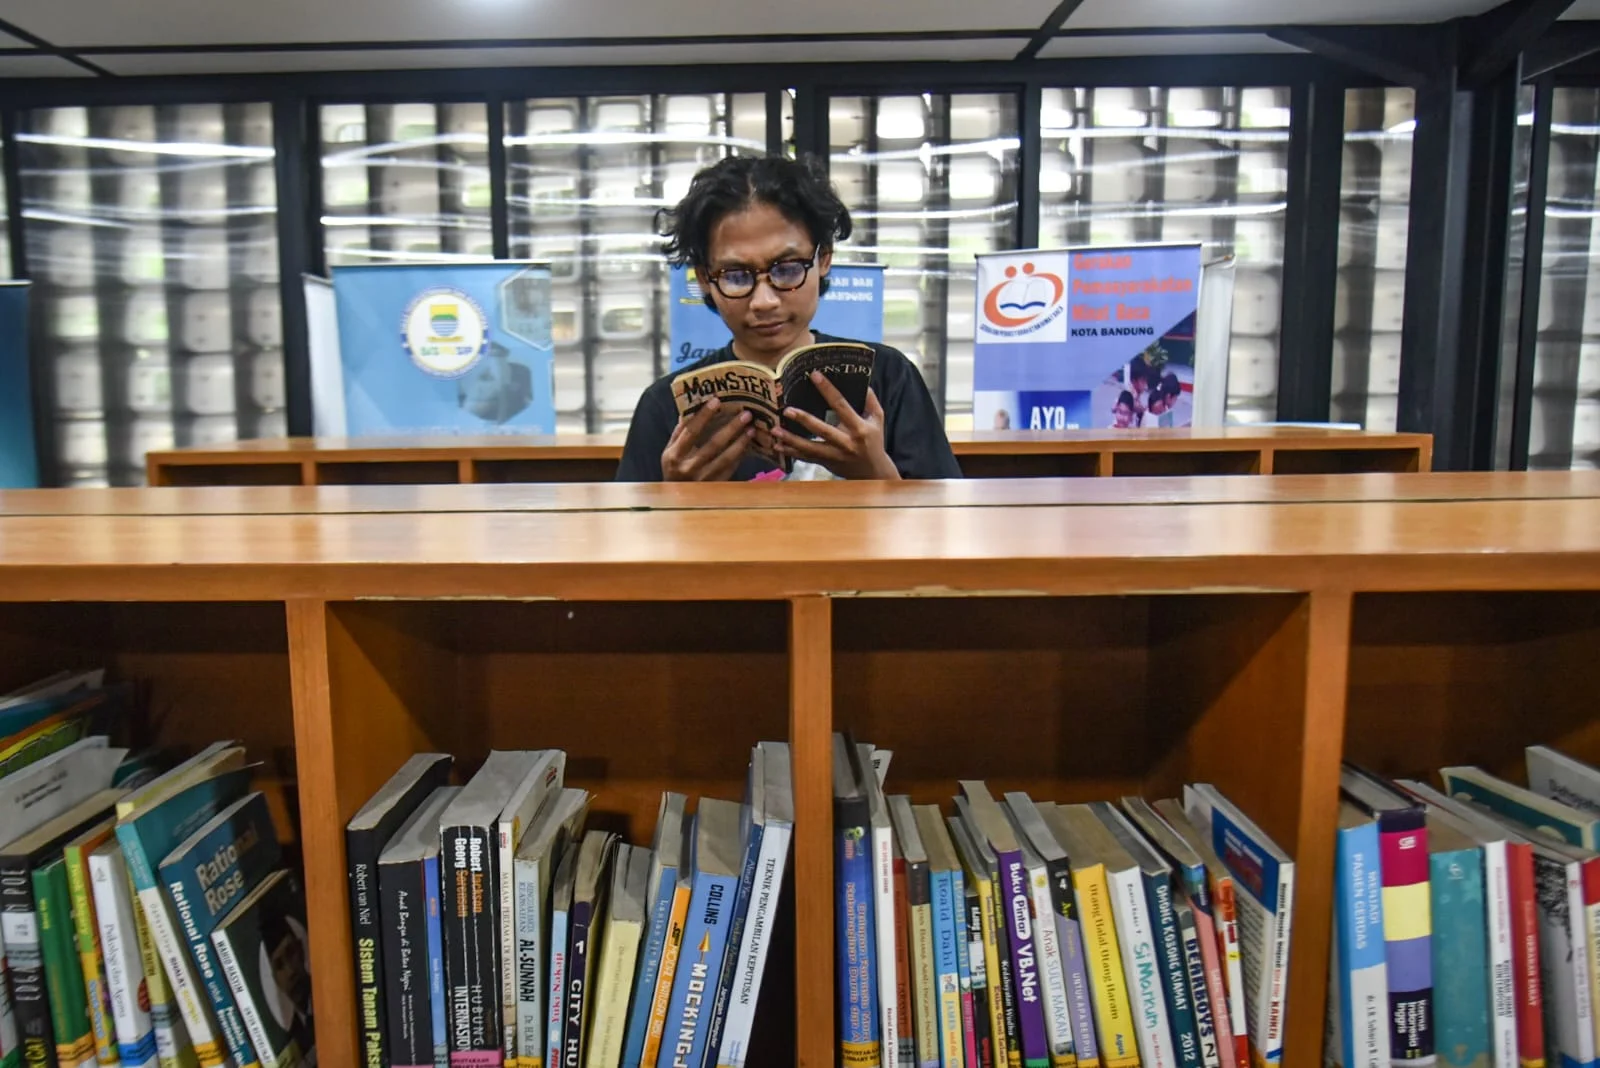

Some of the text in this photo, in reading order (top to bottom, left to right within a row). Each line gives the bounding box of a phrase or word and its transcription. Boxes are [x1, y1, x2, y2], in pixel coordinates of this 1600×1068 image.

[1074, 253, 1131, 270] Gerakan
[1071, 327, 1154, 337] KOTA BANDUNG
[1116, 303, 1150, 320] Baca
[683, 371, 773, 405] MONSTER
[452, 837, 468, 868] Georg
[468, 836, 484, 913] Robert Jackson
[204, 869, 244, 917] Rose
[354, 863, 371, 924] Robert van Niel
[703, 883, 724, 925] COLLINS
[1351, 853, 1367, 948] PASIEN CERDAS
[1366, 869, 1379, 924] MENJADI
[169, 880, 196, 941] Rational
[193, 942, 214, 979] Rose
[740, 857, 776, 1005] TEKNIK PENGAMBILAN KEPUTUSAN
[938, 877, 952, 967] Roald Dahl
[1010, 861, 1037, 1002] Buku Pintar VB.Net
[217, 940, 233, 966] WAHID
[226, 966, 243, 994] HASYIM
[356, 936, 378, 984] Sistem
[502, 956, 512, 979] ALAM
[517, 938, 536, 1002] AL-SUNNAH
[957, 930, 968, 968] Dahl
[1133, 941, 1151, 960] Si
[1155, 883, 1195, 1061] OMONG KOSONG KIAMAT 2012
[550, 951, 563, 1023] Yuki Nakaji
[569, 979, 582, 1024] CITY
[715, 986, 728, 1016] Jaringan
[1042, 928, 1067, 1038] Anak SULIT MAKAN
[1072, 972, 1083, 1001] UNTUK
[360, 985, 381, 1029] Tanam
[469, 983, 484, 1046] HUBUNG
[1076, 1001, 1087, 1020] APA
[1392, 1001, 1409, 1034] Inggris
[1404, 1000, 1420, 1047] Indonesia
[1414, 998, 1429, 1031] Kamus
